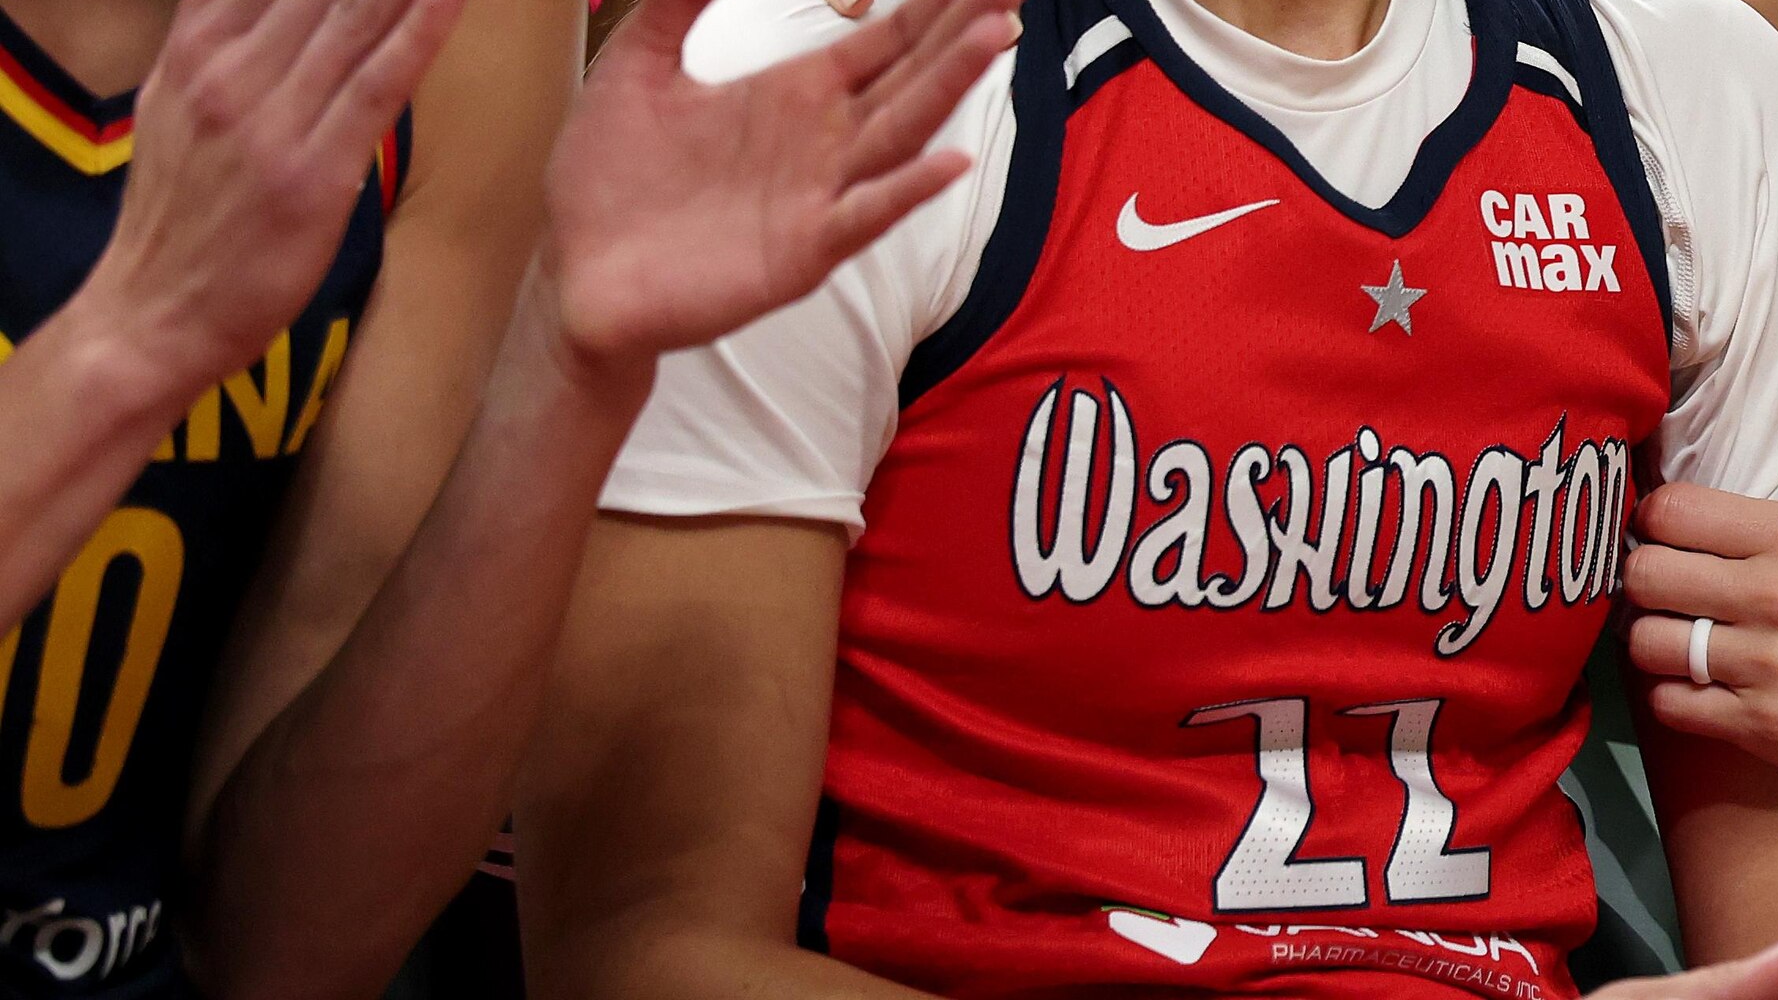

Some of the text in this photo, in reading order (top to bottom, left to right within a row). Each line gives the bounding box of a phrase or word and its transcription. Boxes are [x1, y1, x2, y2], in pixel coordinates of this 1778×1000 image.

[1480, 190, 1590, 240] CAR
[1491, 241, 1621, 292] max
[1010, 375, 1630, 659] Washington
[1179, 695, 1492, 915] 22
[1270, 942, 1511, 993] PHARMACEUTICALS
